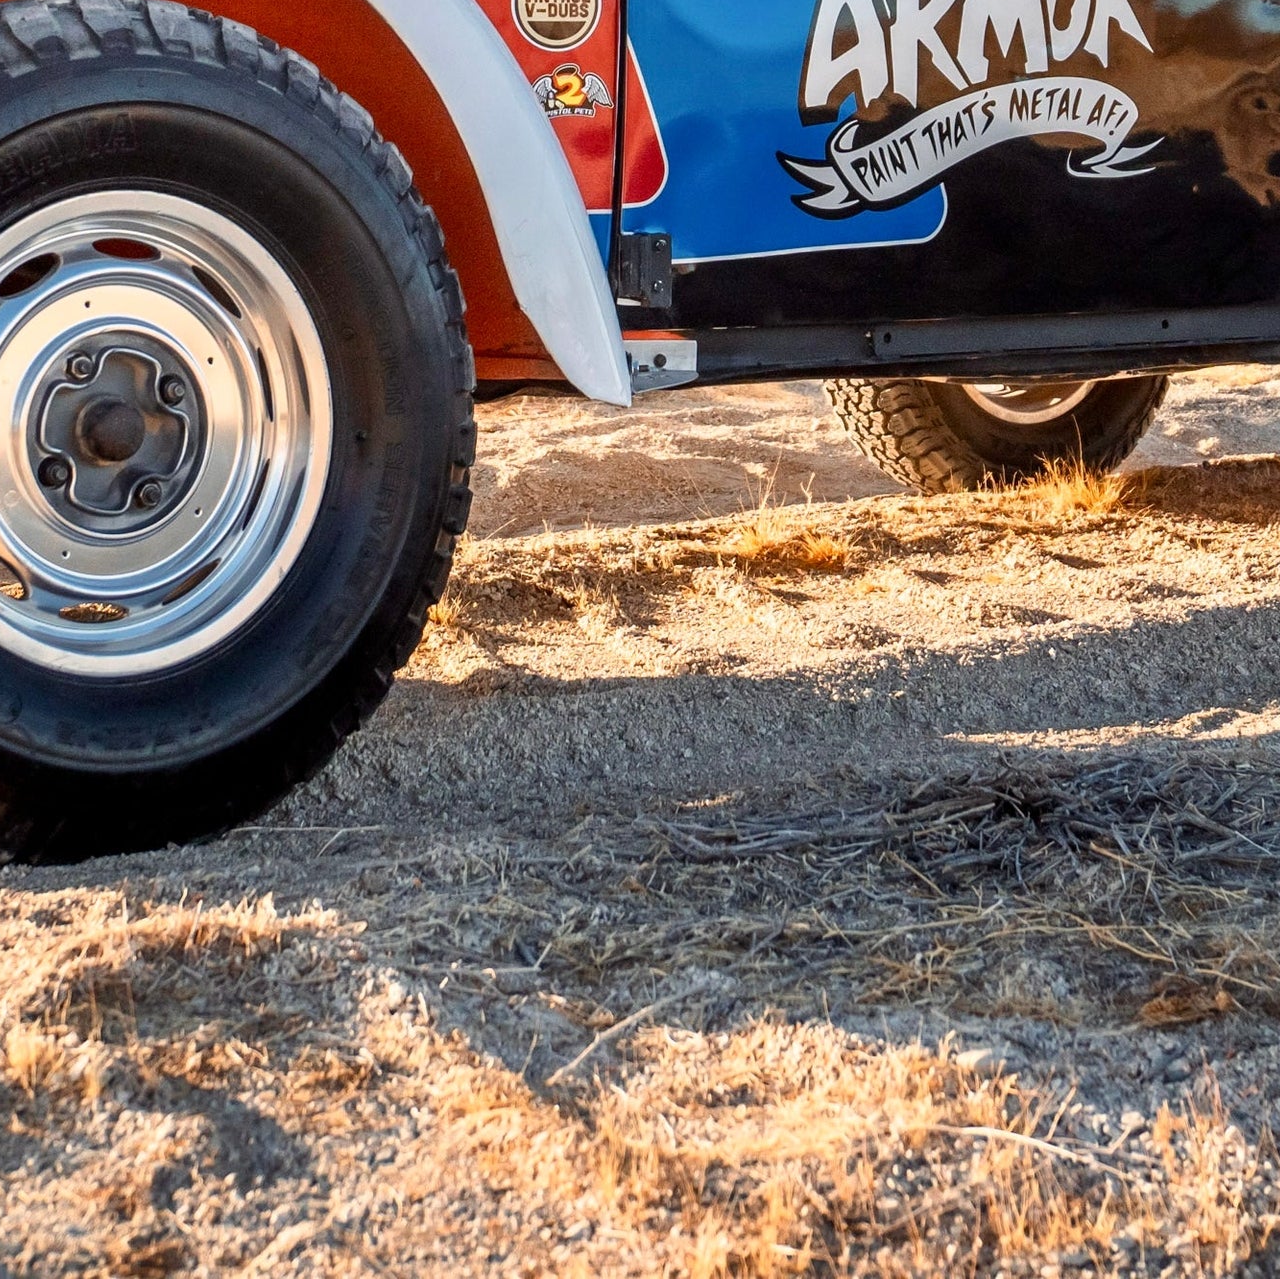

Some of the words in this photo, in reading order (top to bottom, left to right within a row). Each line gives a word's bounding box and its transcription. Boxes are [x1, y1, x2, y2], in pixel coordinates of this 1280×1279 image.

[524, 3, 590, 18] V-DUBS
[574, 108, 594, 116] PETE
[850, 128, 921, 195] PAINT
[921, 91, 998, 161] THAT'S
[1008, 87, 1083, 124] METAL
[1086, 93, 1130, 137] AF!
